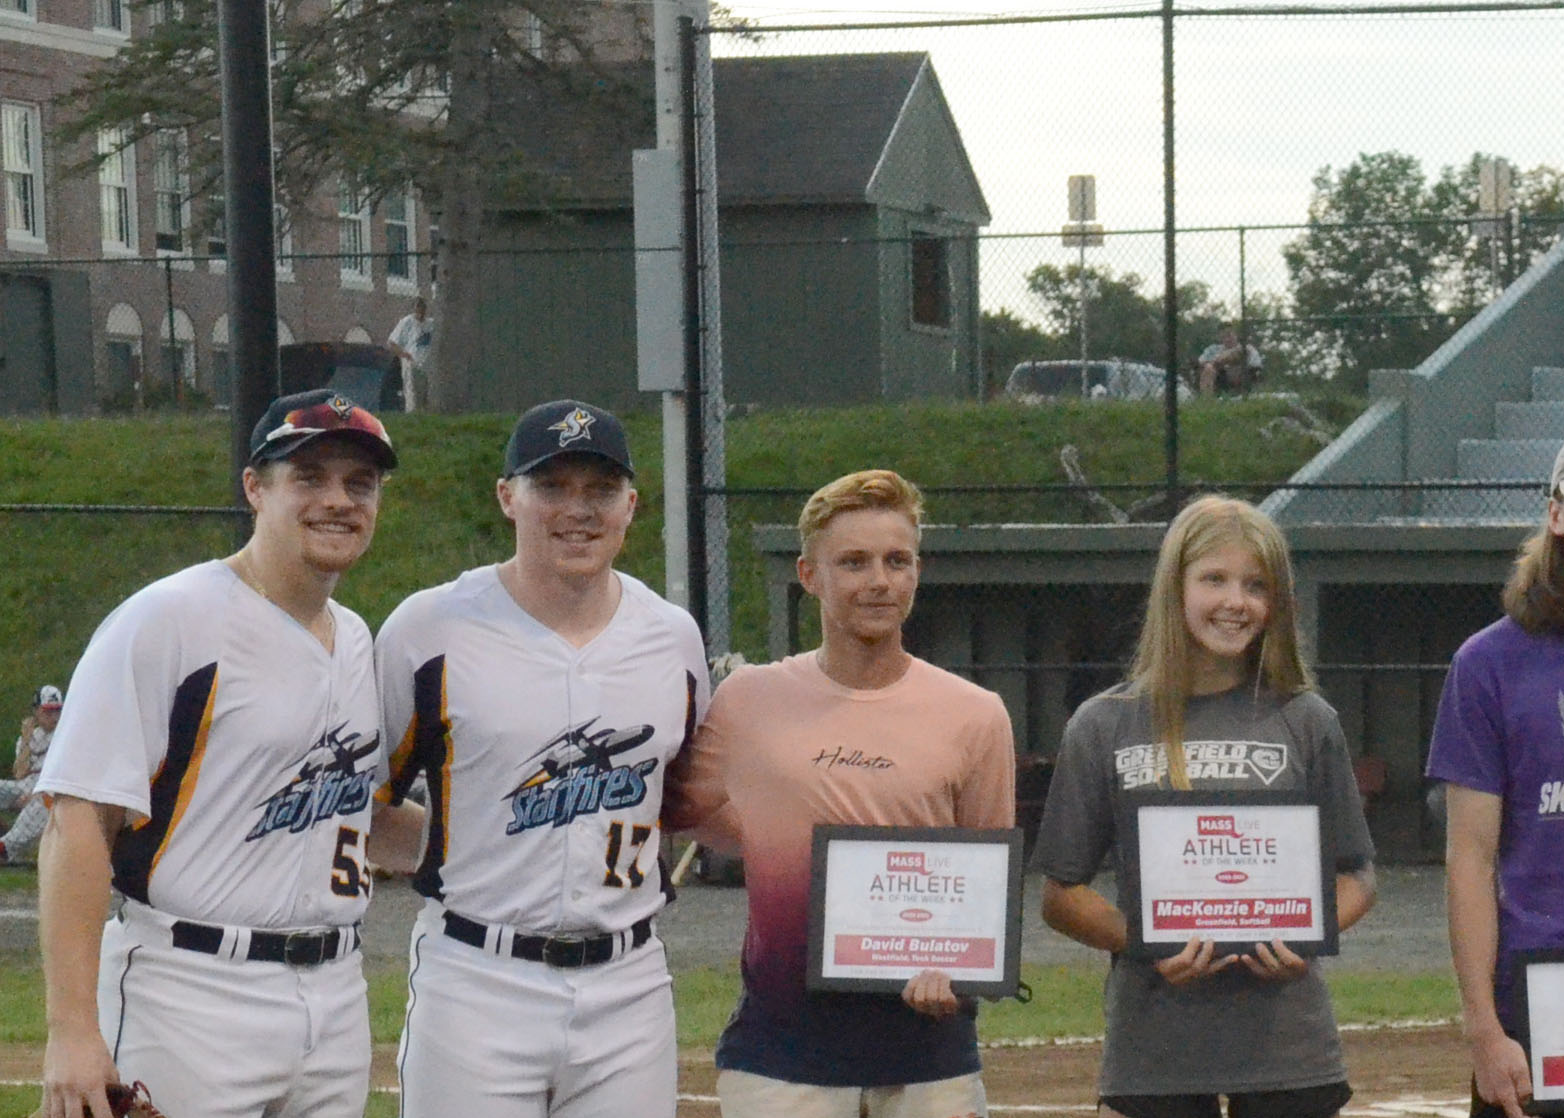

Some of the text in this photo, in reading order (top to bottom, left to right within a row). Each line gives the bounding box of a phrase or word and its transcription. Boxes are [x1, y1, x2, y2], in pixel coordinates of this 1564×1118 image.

[811, 746, 895, 770] Hollister
[1116, 743, 1248, 771] GREEFIELD
[1123, 762, 1250, 790] SOFBALL
[506, 758, 659, 835] Starfires
[1200, 820, 1261, 831] MASS LIVE
[603, 819, 652, 889] 17
[1182, 838, 1277, 856] ATHLETE
[890, 855, 951, 868] MASS LIVE
[870, 874, 966, 894] ATHLETE
[1156, 901, 1307, 917] MacKenzie Paulin
[861, 937, 969, 953] David Bulatov
